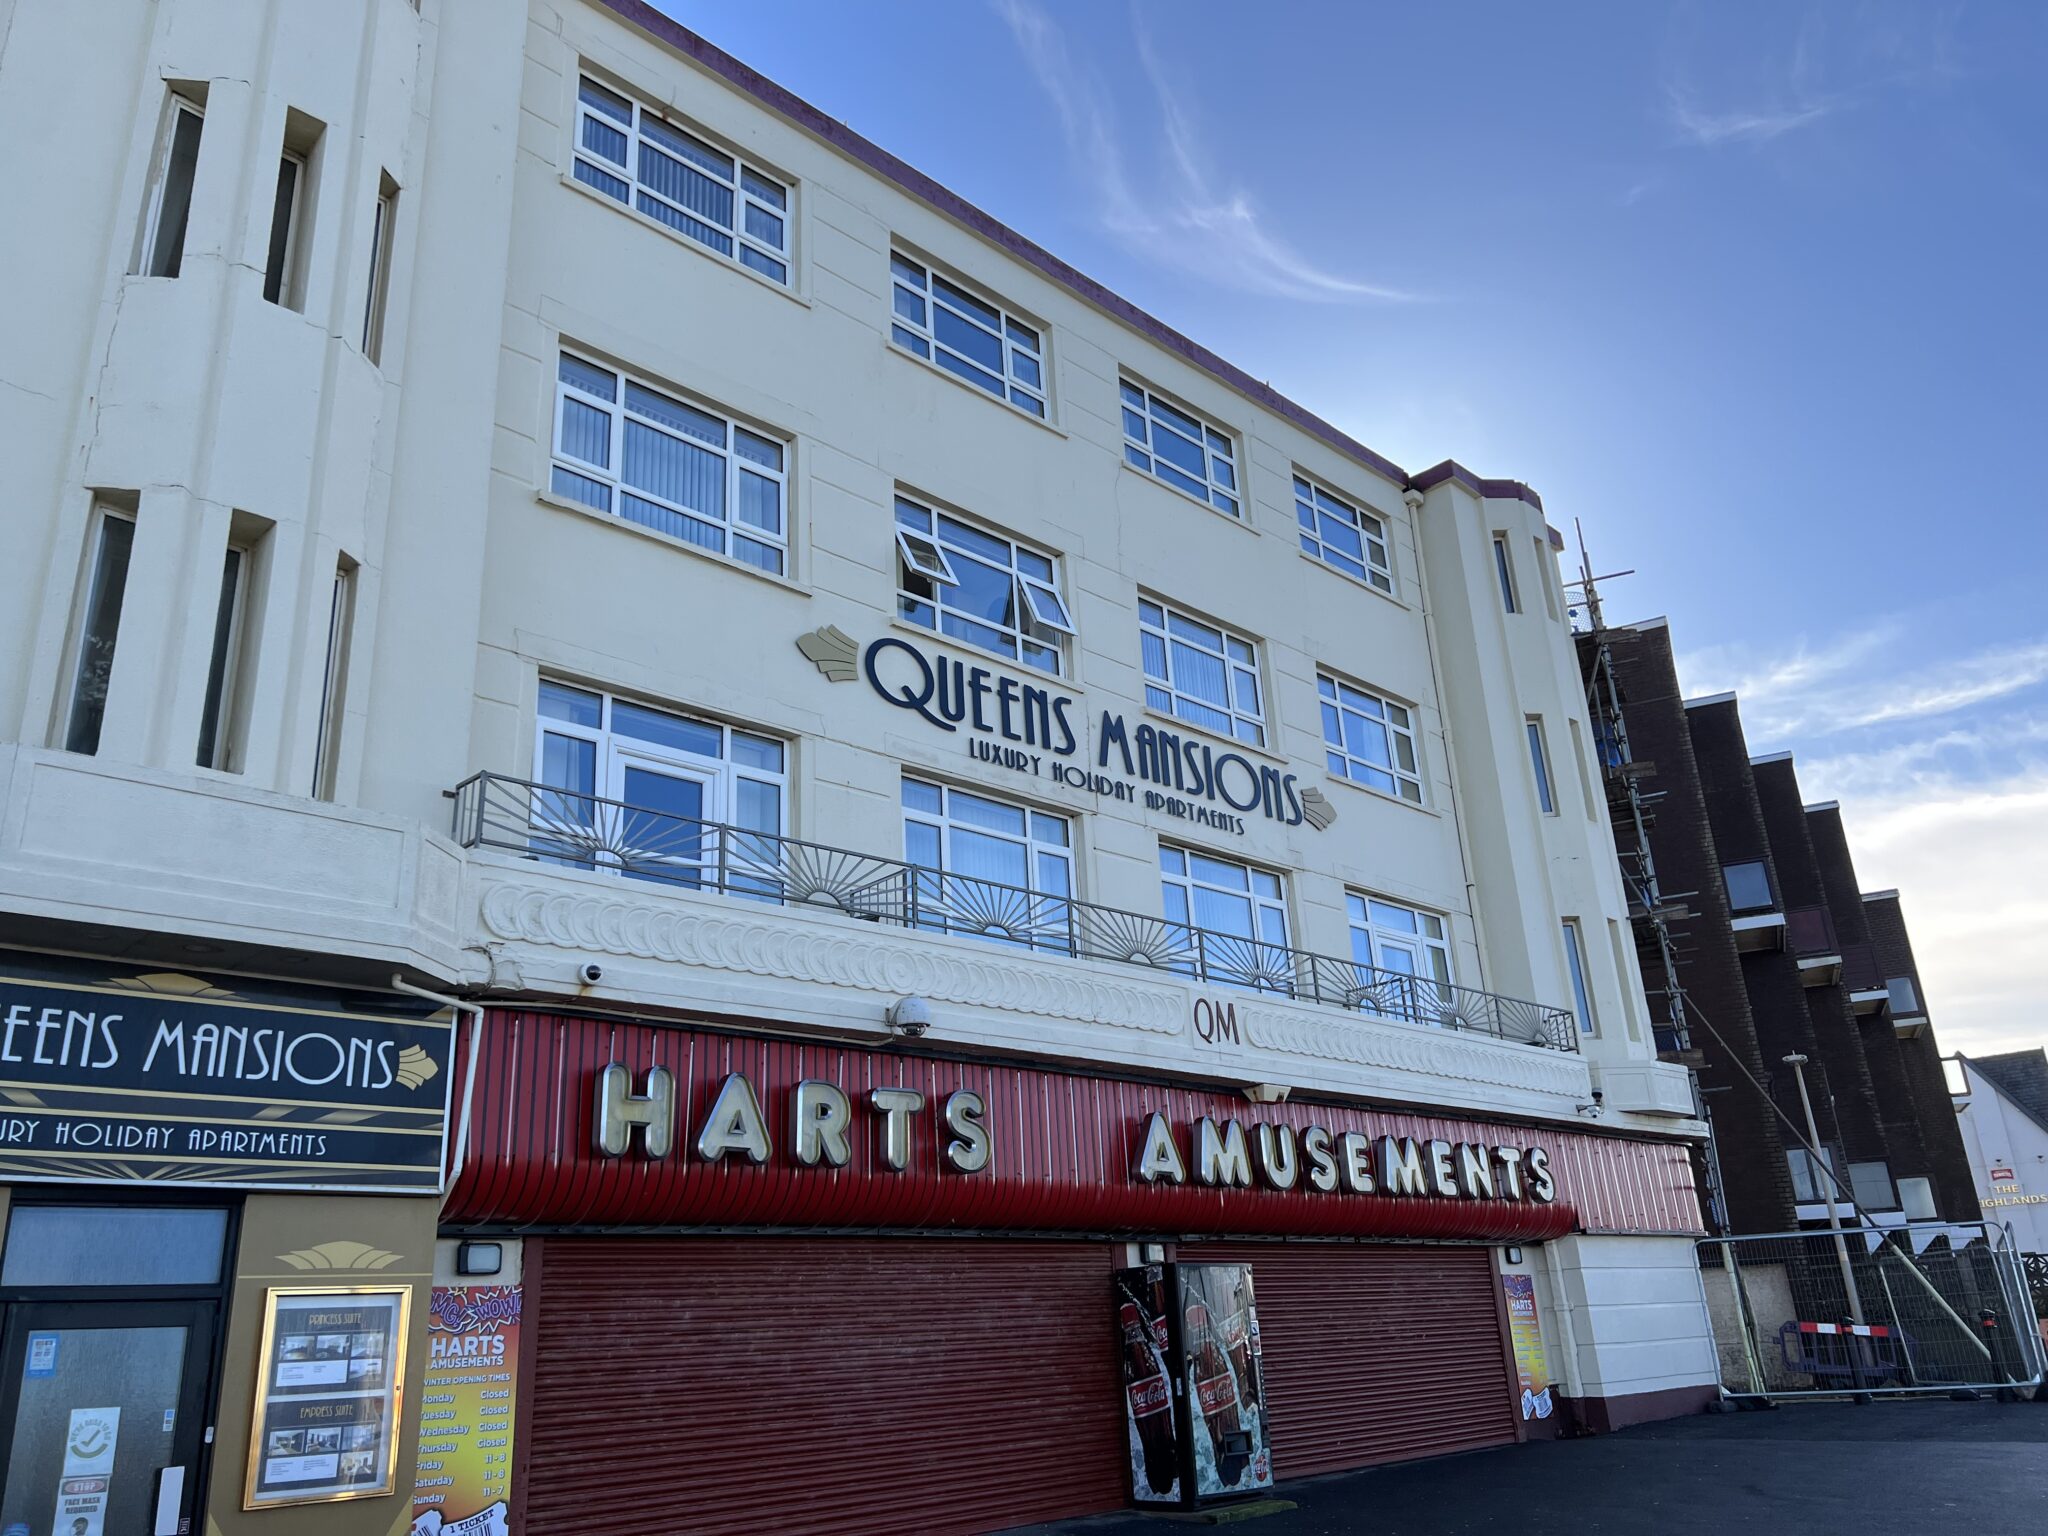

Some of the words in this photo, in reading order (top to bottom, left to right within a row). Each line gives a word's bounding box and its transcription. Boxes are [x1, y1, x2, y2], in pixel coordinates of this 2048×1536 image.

[865, 637, 1077, 755] QUEENS
[1099, 709, 1304, 826] MANSIONS
[969, 737, 1042, 776] LUXURY
[1053, 761, 1135, 803] HOLIDAY
[1145, 789, 1246, 836] APARTMENTS
[1193, 998, 1240, 1045] QM
[0, 1003, 123, 1068] EENS
[142, 1019, 395, 1089] MANSIONS
[595, 1061, 993, 1174] HARTS
[55, 1122, 175, 1149] HOLIDAY
[188, 1129, 327, 1156] APARTMENTS
[1132, 1111, 1557, 1204] AMUSEMENTS
[1994, 1184, 2020, 1194] THE
[1979, 1193, 2048, 1208] IGHLANDS
[476, 1294, 522, 1320] WOW!
[431, 1334, 505, 1358] HARTS
[430, 1356, 504, 1370] AMUSEMENTS
[453, 1375, 487, 1384] OPENING
[489, 1373, 511, 1382] TIMES
[480, 1389, 510, 1399] Closed
[334, 1404, 353, 1416] SUITE
[479, 1405, 509, 1415] Closed
[478, 1420, 508, 1431] Closed
[477, 1436, 507, 1448] Closed
[74, 1482, 96, 1492] STOP
[457, 1509, 494, 1530] TICKET
